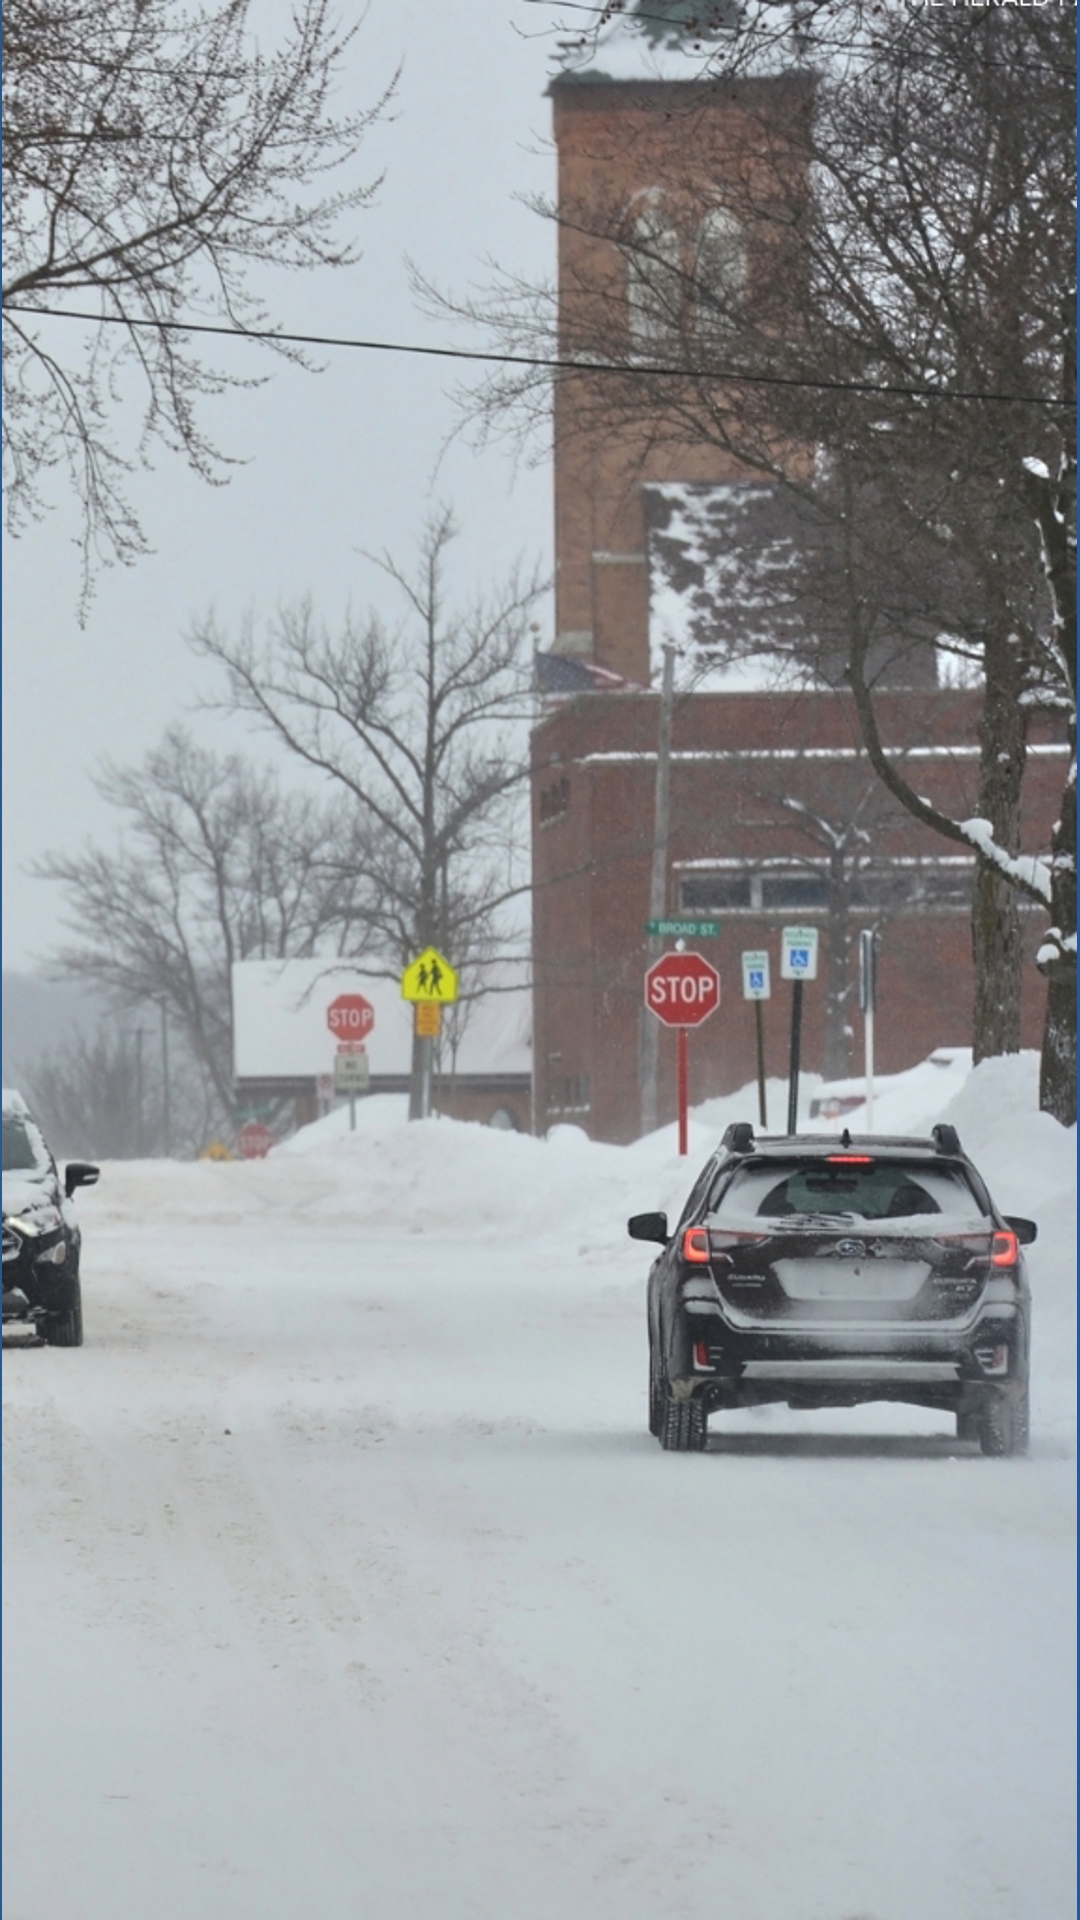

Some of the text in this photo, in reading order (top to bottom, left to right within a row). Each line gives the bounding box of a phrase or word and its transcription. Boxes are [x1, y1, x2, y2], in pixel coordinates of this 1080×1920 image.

[658, 921, 696, 936] BROAD
[651, 975, 714, 1003] STOP
[330, 1008, 372, 1027] STOP
[240, 1135, 272, 1150] STOP
